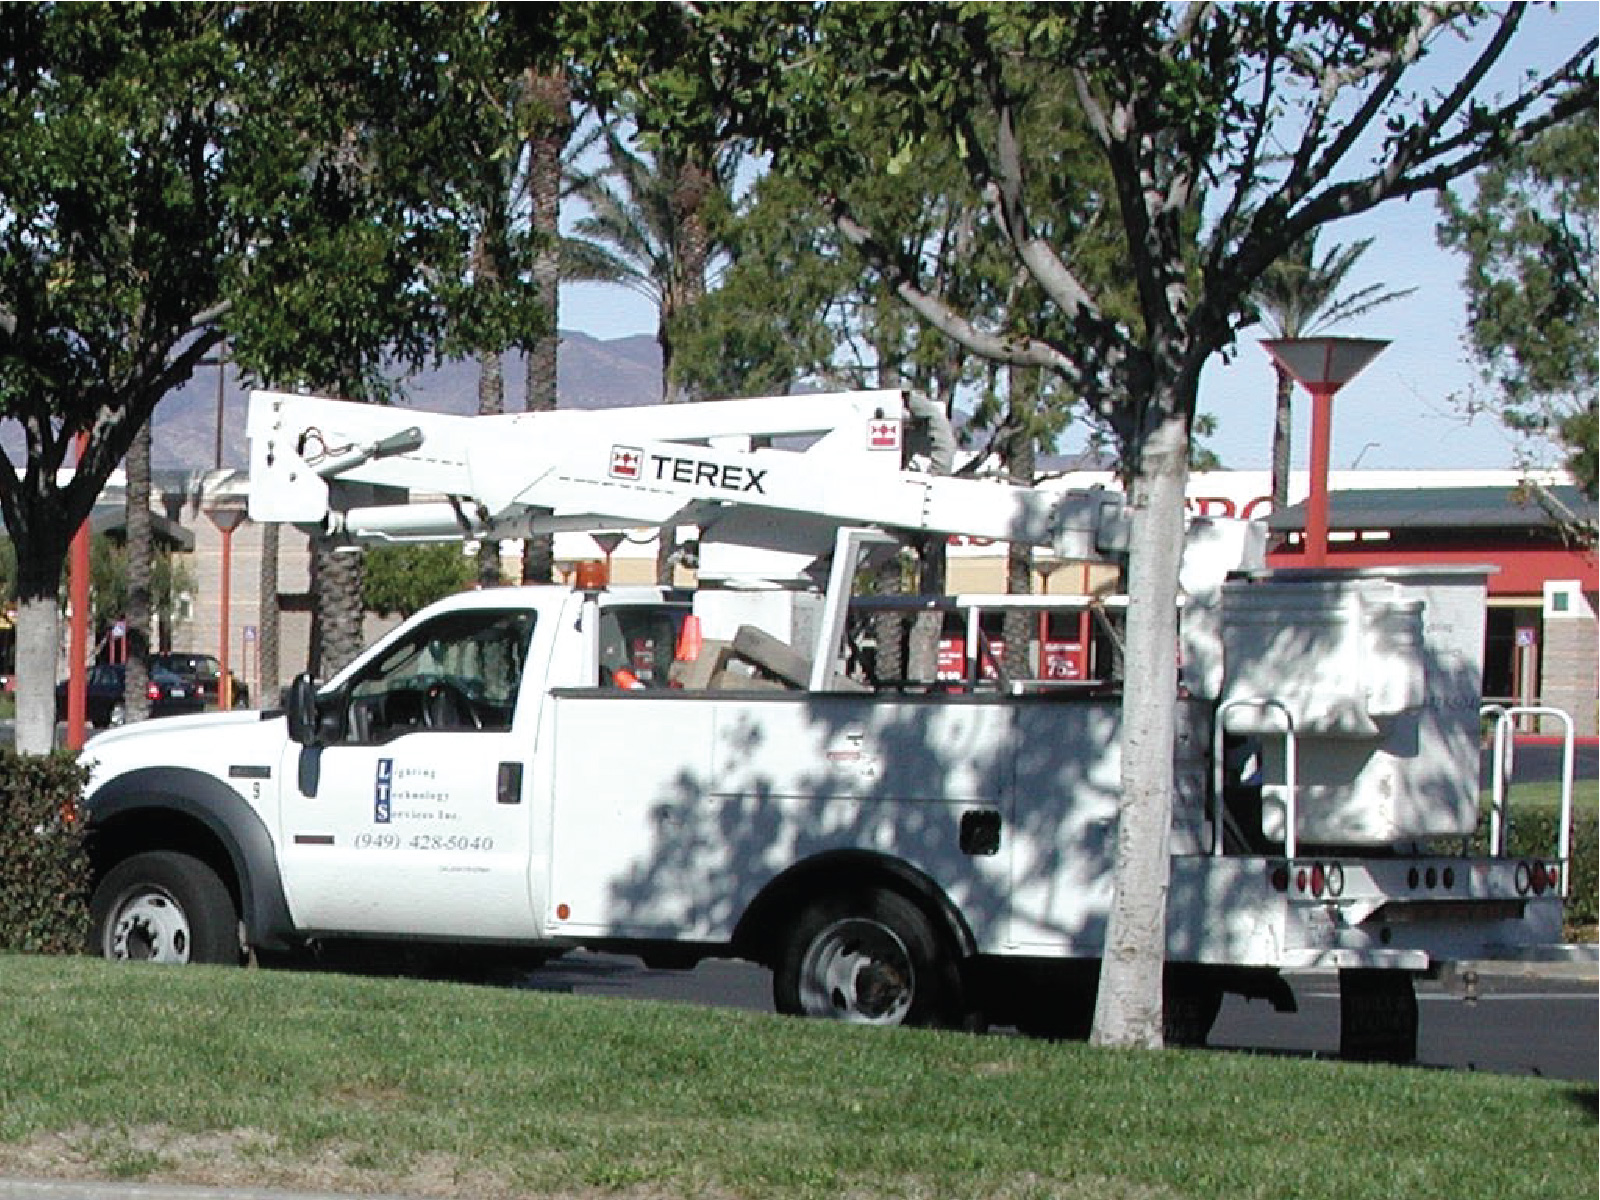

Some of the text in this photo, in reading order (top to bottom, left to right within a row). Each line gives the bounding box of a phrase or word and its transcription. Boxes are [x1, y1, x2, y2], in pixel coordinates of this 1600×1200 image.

[651, 454, 768, 494] TEREX
[354, 833, 494, 850] (949) 428-5040
